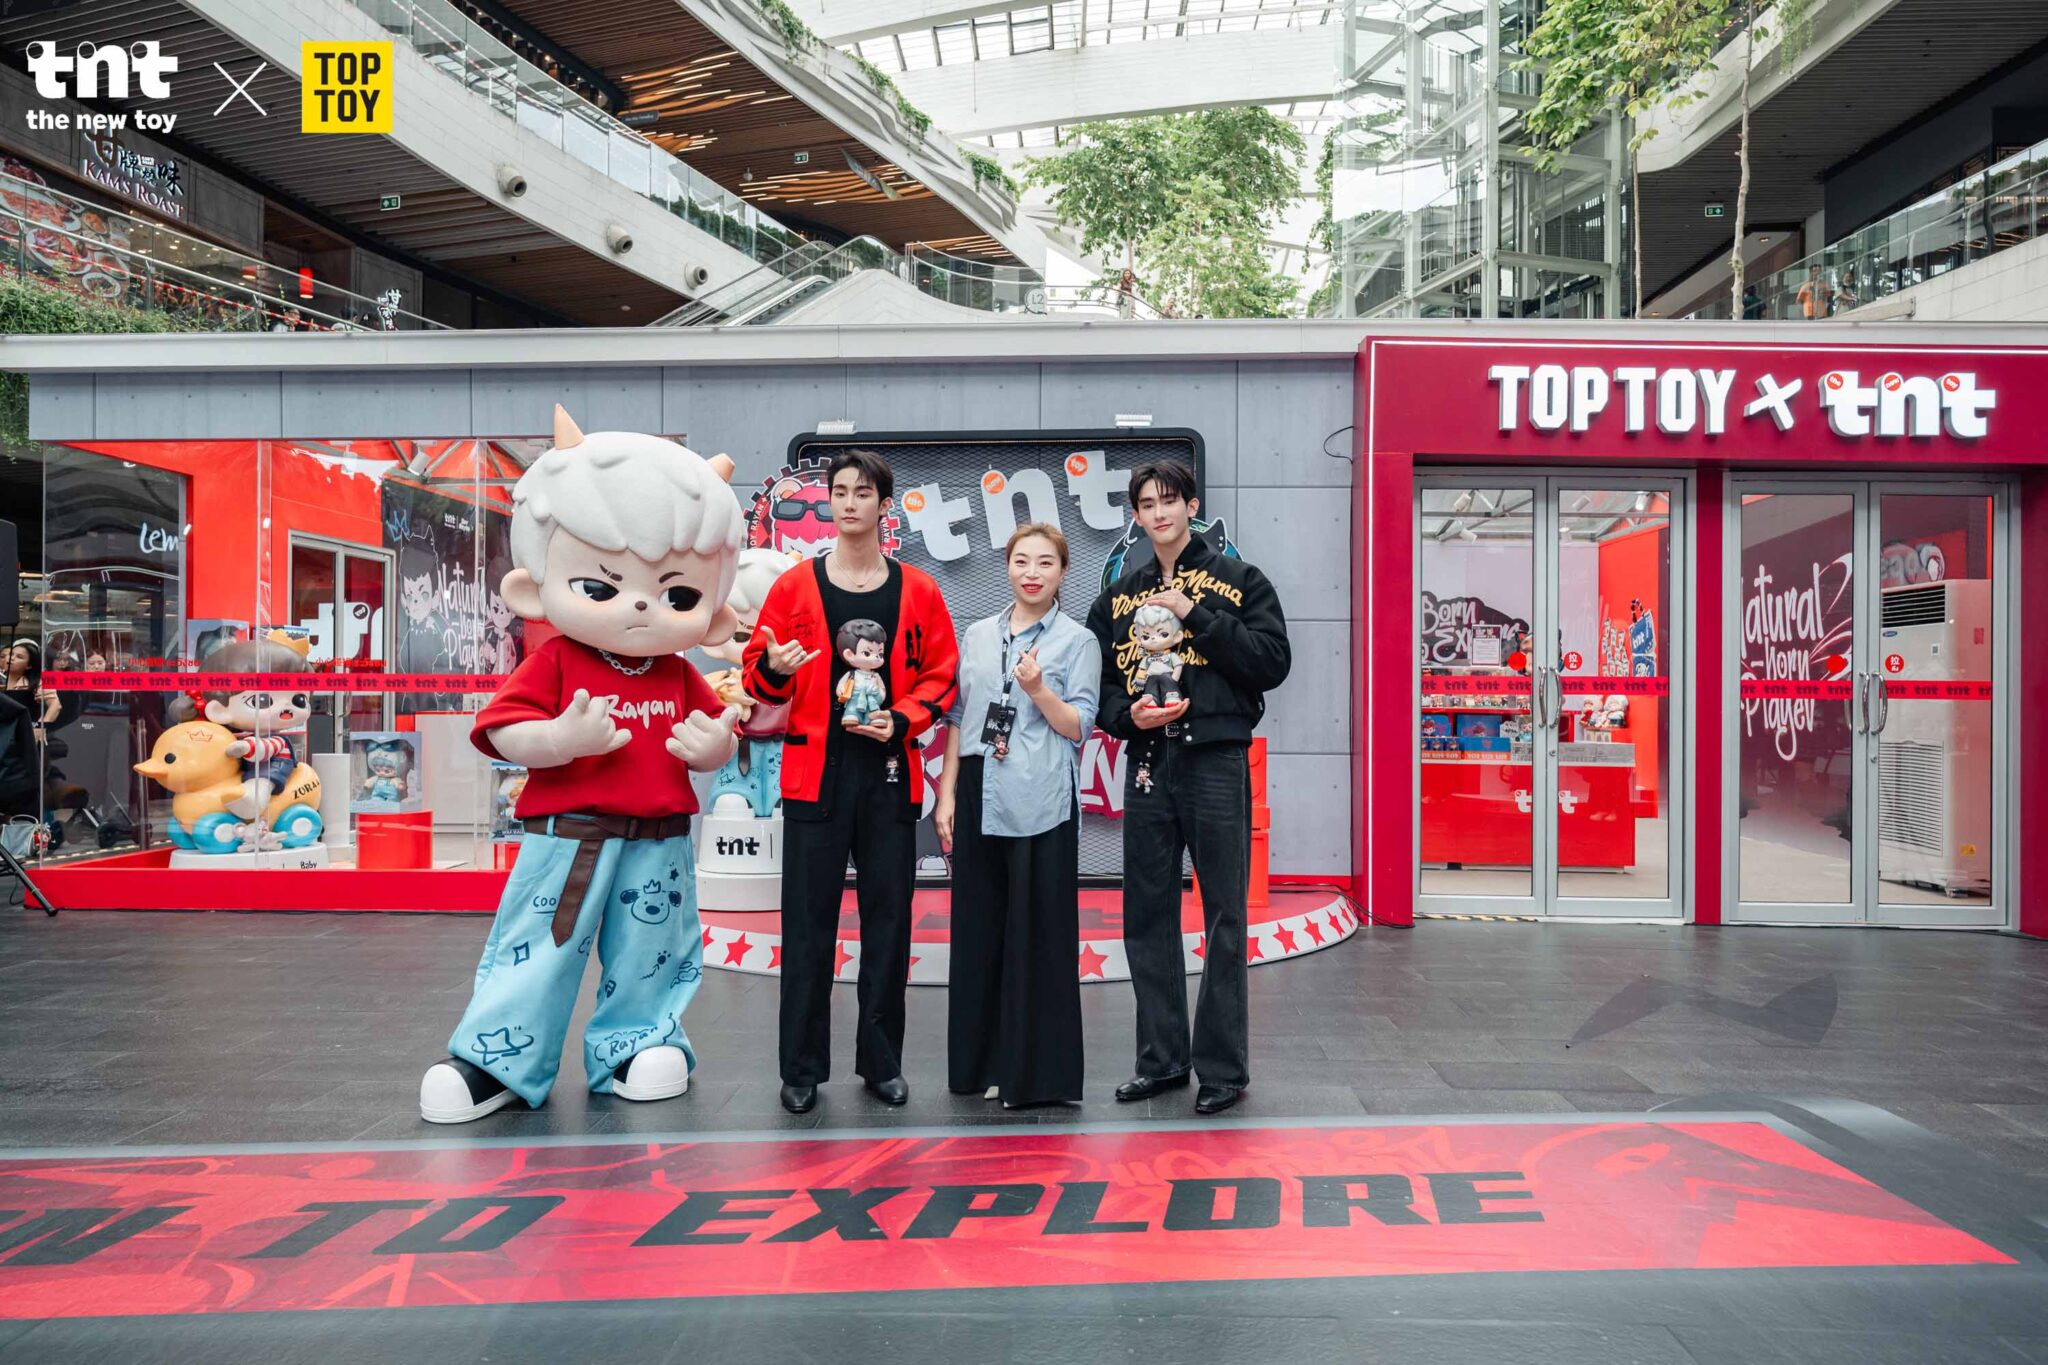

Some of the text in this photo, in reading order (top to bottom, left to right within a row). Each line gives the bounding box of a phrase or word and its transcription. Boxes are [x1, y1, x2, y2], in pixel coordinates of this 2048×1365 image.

[136, 182, 184, 218] ROAST
[1885, 378, 1900, 389] new
[1946, 378, 1959, 389] toy
[1488, 364, 1609, 433] TOP
[1612, 366, 1737, 436] TOY
[1818, 370, 1997, 439] tnt
[902, 451, 1132, 561] tnt
[63, 676, 84, 686] tnt
[92, 676, 113, 686] tnt
[120, 676, 142, 686] tnt
[150, 676, 171, 686] tnt
[178, 676, 201, 687] tnt
[208, 676, 231, 687] tnt
[239, 676, 261, 687] tnt
[268, 676, 290, 687] tnt
[296, 676, 319, 687] tnt
[325, 677, 348, 687] tnt
[385, 677, 407, 688] tnt
[415, 677, 437, 688] tnt
[445, 677, 467, 688] tnt
[475, 677, 498, 688] tnt
[1422, 681, 1531, 690] nt tnt tnt tnt
[1562, 680, 1585, 690] tnt
[1592, 681, 1617, 690] tnt
[1624, 681, 1648, 690] tnt
[1741, 684, 1851, 695] nt tnt tnt tnt
[1914, 685, 1938, 695] tnt
[1945, 685, 1970, 695] tnt
[604, 695, 676, 729] Rayan
[716, 837, 761, 856] tnt
[300, 861, 318, 869] Baby
[533, 895, 557, 907] COO
[609, 1026, 658, 1057] Rayan
[235, 1195, 566, 1259] TO
[630, 1170, 1545, 1247] EXPLORE
